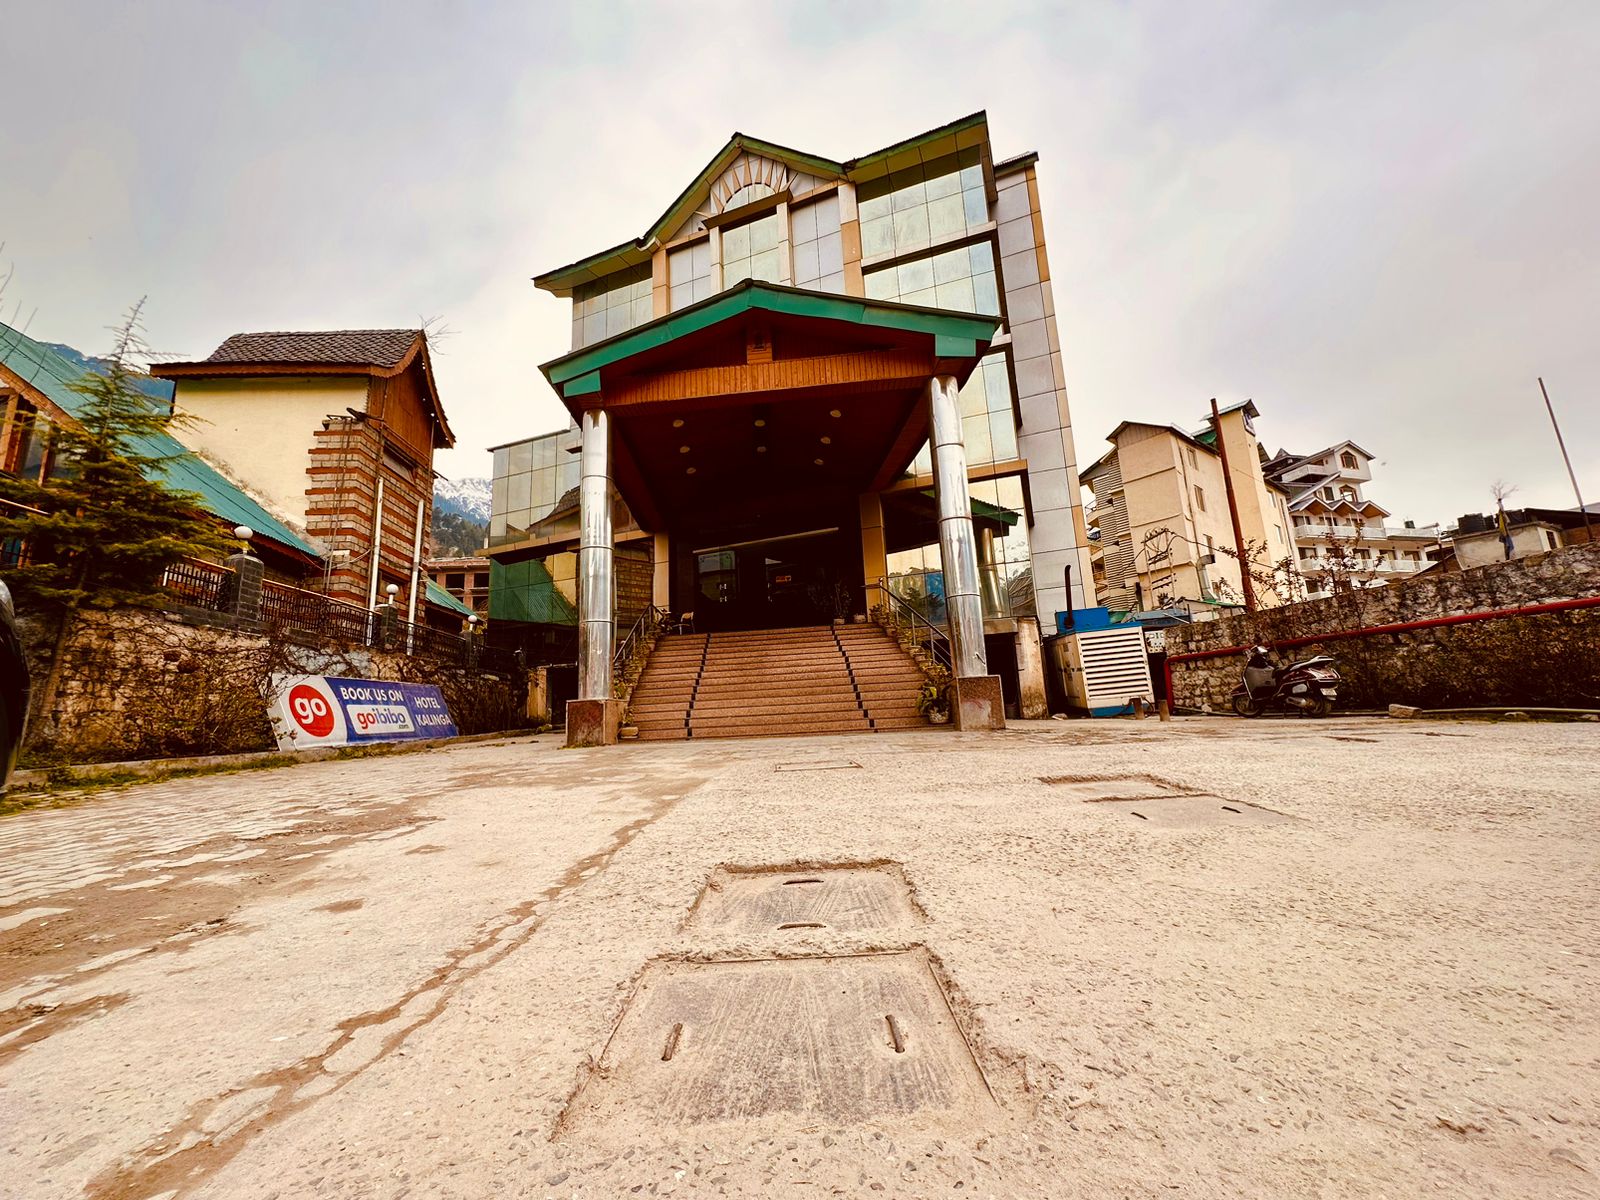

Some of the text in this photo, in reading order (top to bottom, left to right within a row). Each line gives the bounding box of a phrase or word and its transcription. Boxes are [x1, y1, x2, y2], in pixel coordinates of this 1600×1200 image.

[340, 687, 404, 701] BOOK US ON
[414, 696, 441, 709] HOTEL
[294, 697, 327, 724] go
[357, 708, 406, 729] goibibo
[415, 714, 453, 726] KALINGA
